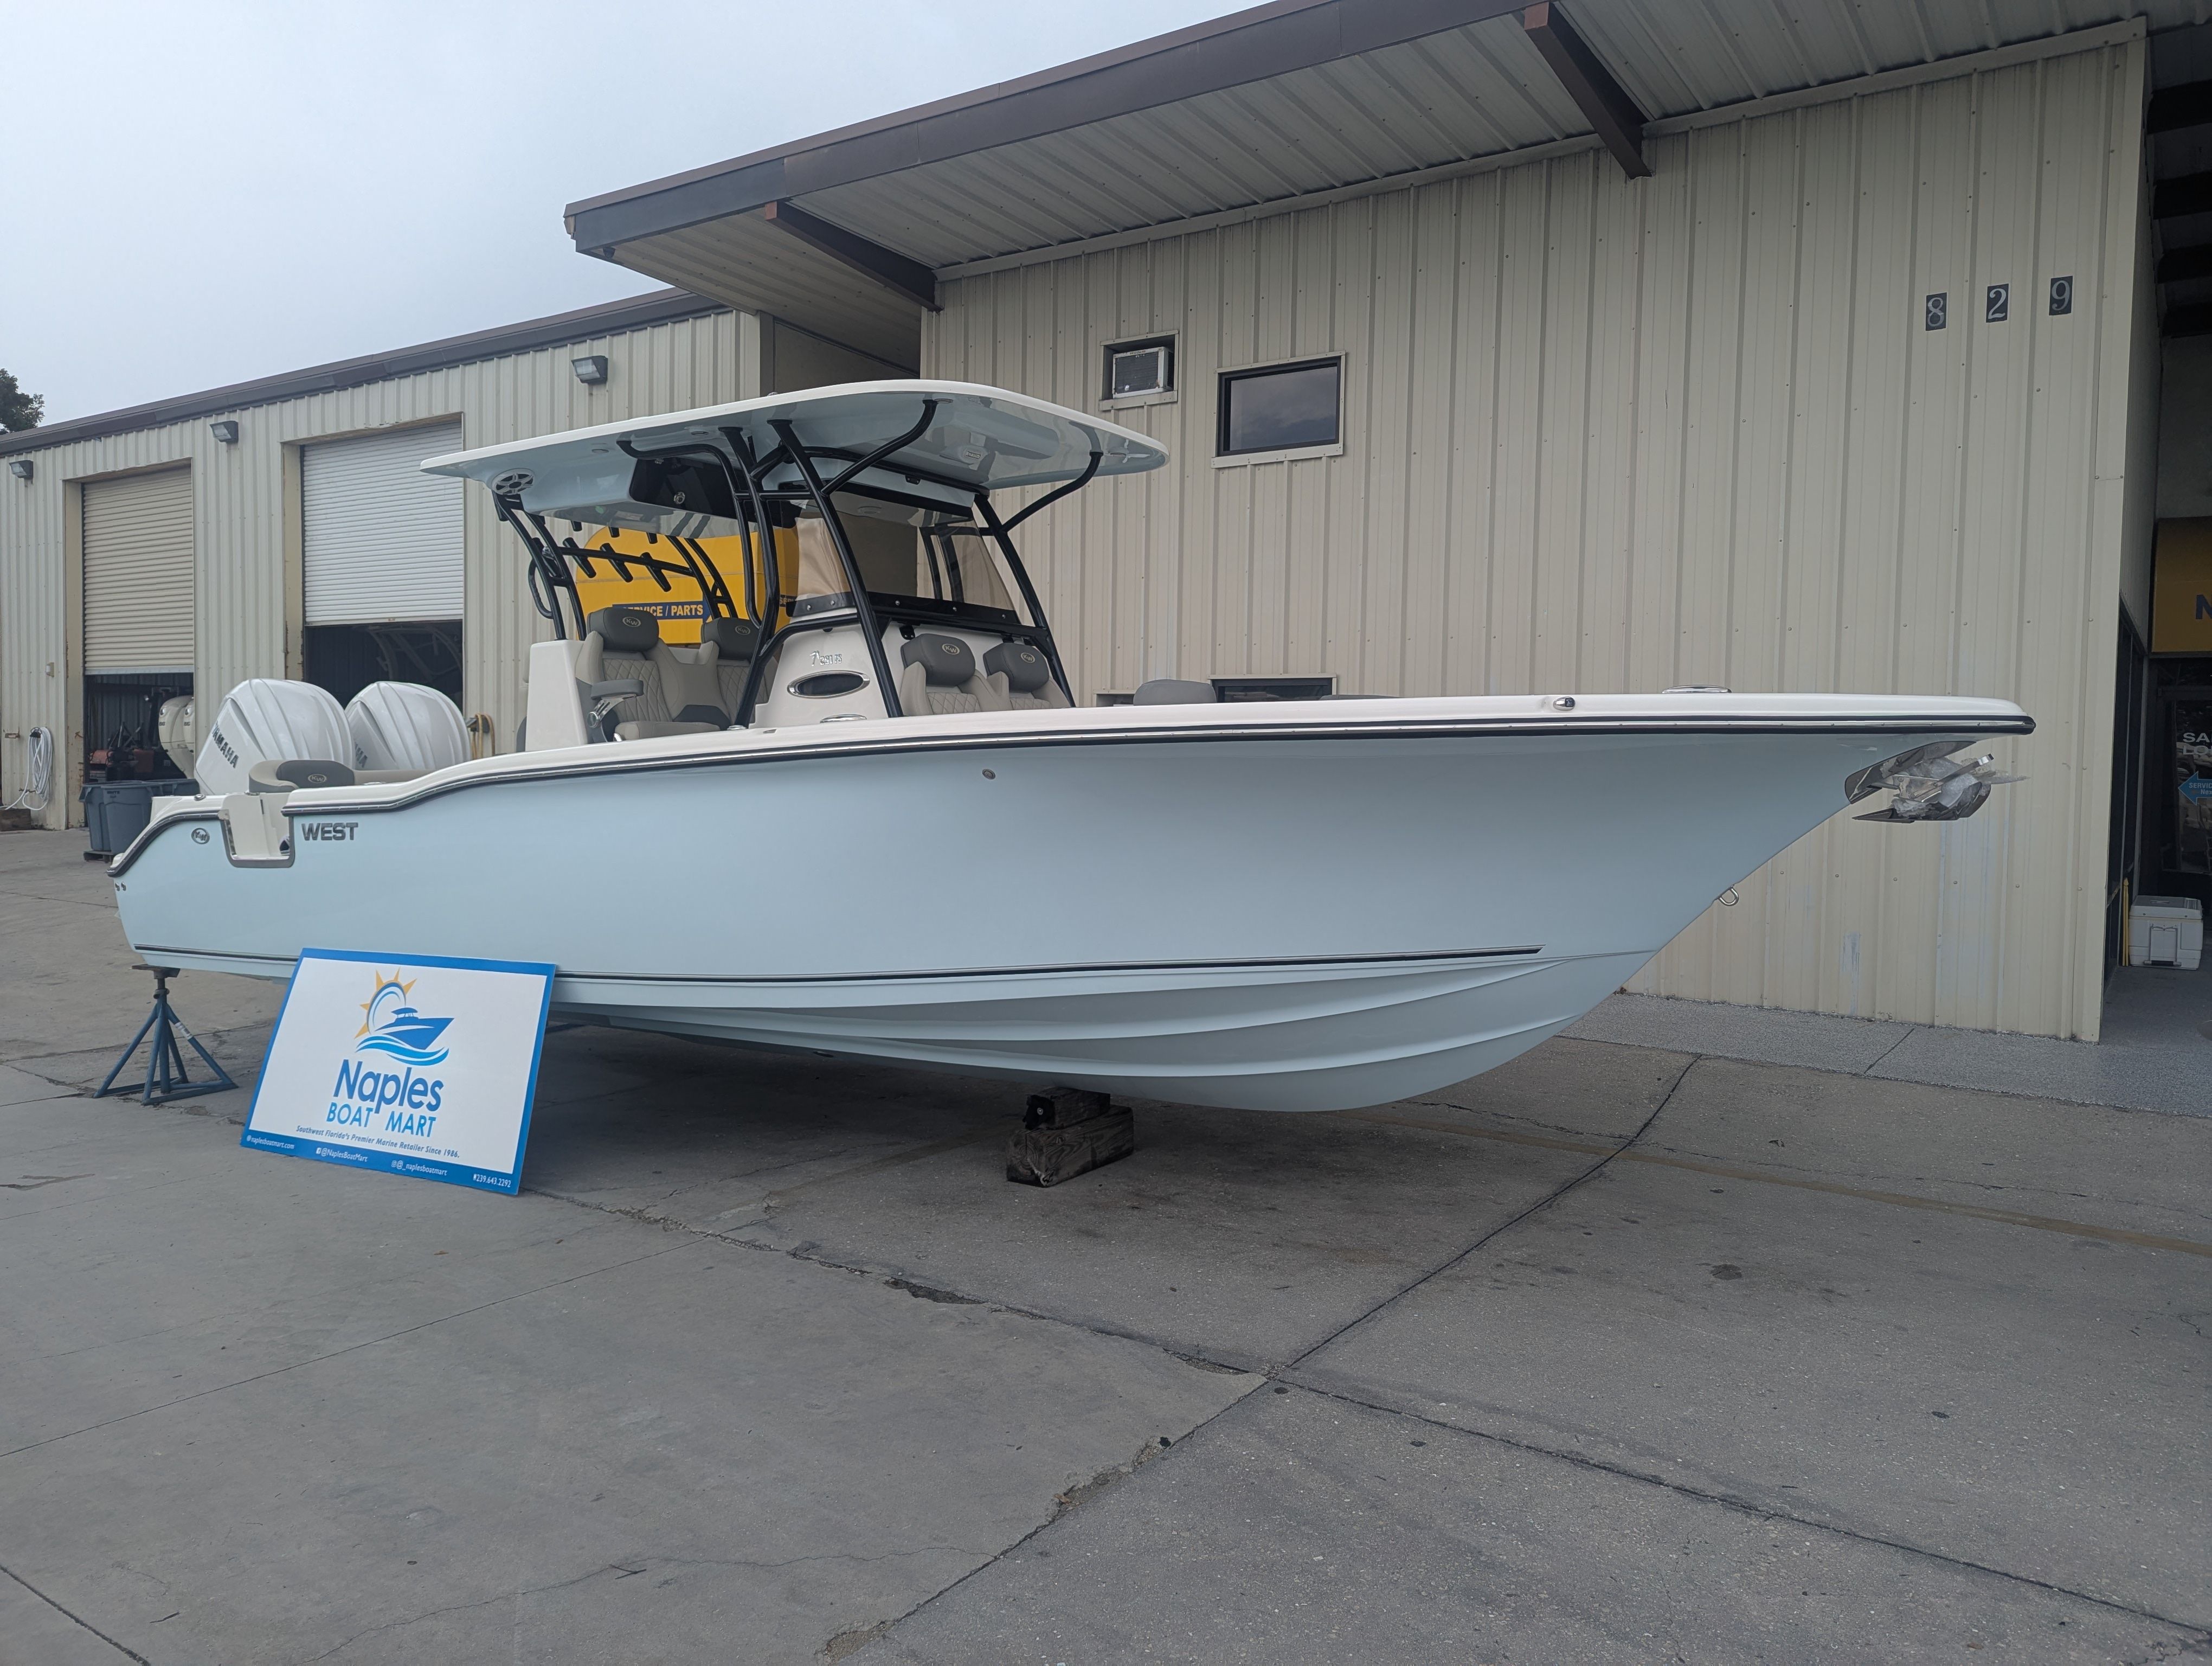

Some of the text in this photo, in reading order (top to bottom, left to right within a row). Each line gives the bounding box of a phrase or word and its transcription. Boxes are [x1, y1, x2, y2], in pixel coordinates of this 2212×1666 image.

[671, 604, 703, 616] PARTS
[2183, 732, 2212, 743] SA
[301, 822, 358, 841] WEST
[333, 1059, 444, 1114] Naples
[326, 1101, 436, 1137] BOAT MART
[250, 1137, 295, 1149] naplesboatmart.com
[296, 1125, 460, 1158] Southwest Florida's Premier Marine Retailer Since 1986.
[321, 1147, 369, 1163] @NaplesBoatMart
[476, 1174, 512, 1188] 239.643.2292
